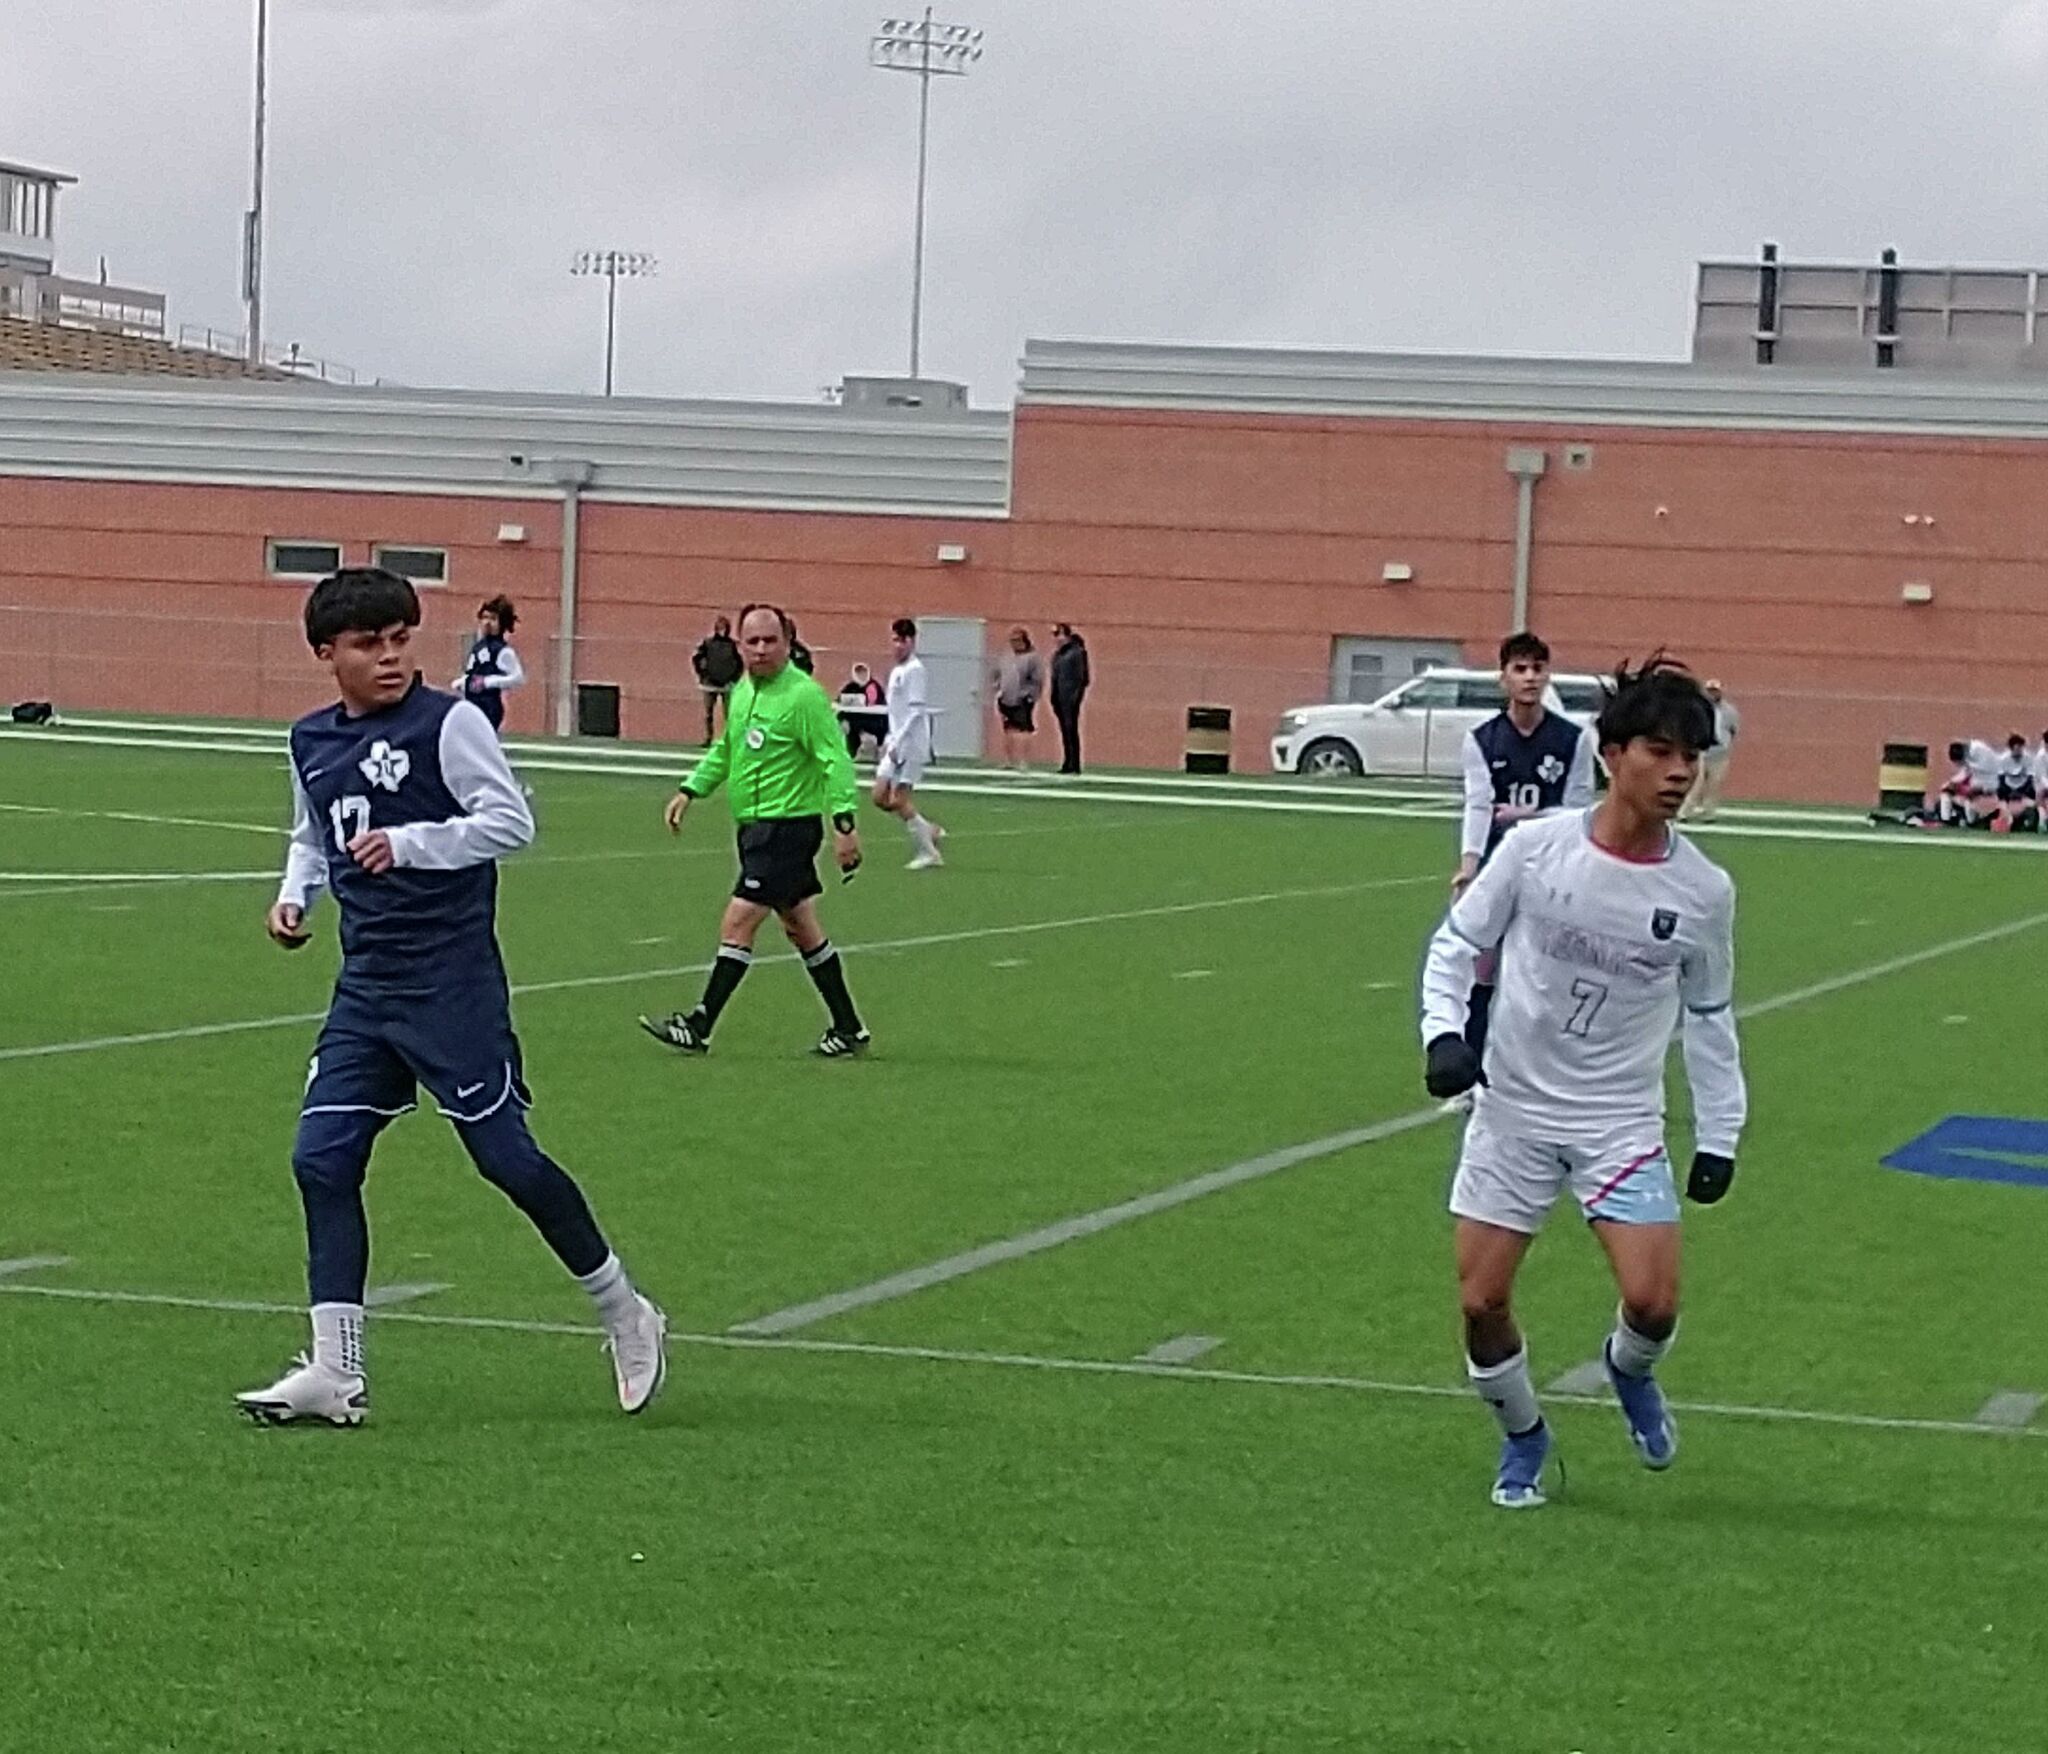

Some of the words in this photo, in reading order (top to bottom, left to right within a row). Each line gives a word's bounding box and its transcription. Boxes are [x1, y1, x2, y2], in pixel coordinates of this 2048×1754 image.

[329, 795, 371, 853] 17
[1508, 782, 1540, 809] 10
[1562, 977, 1608, 1038] 7
